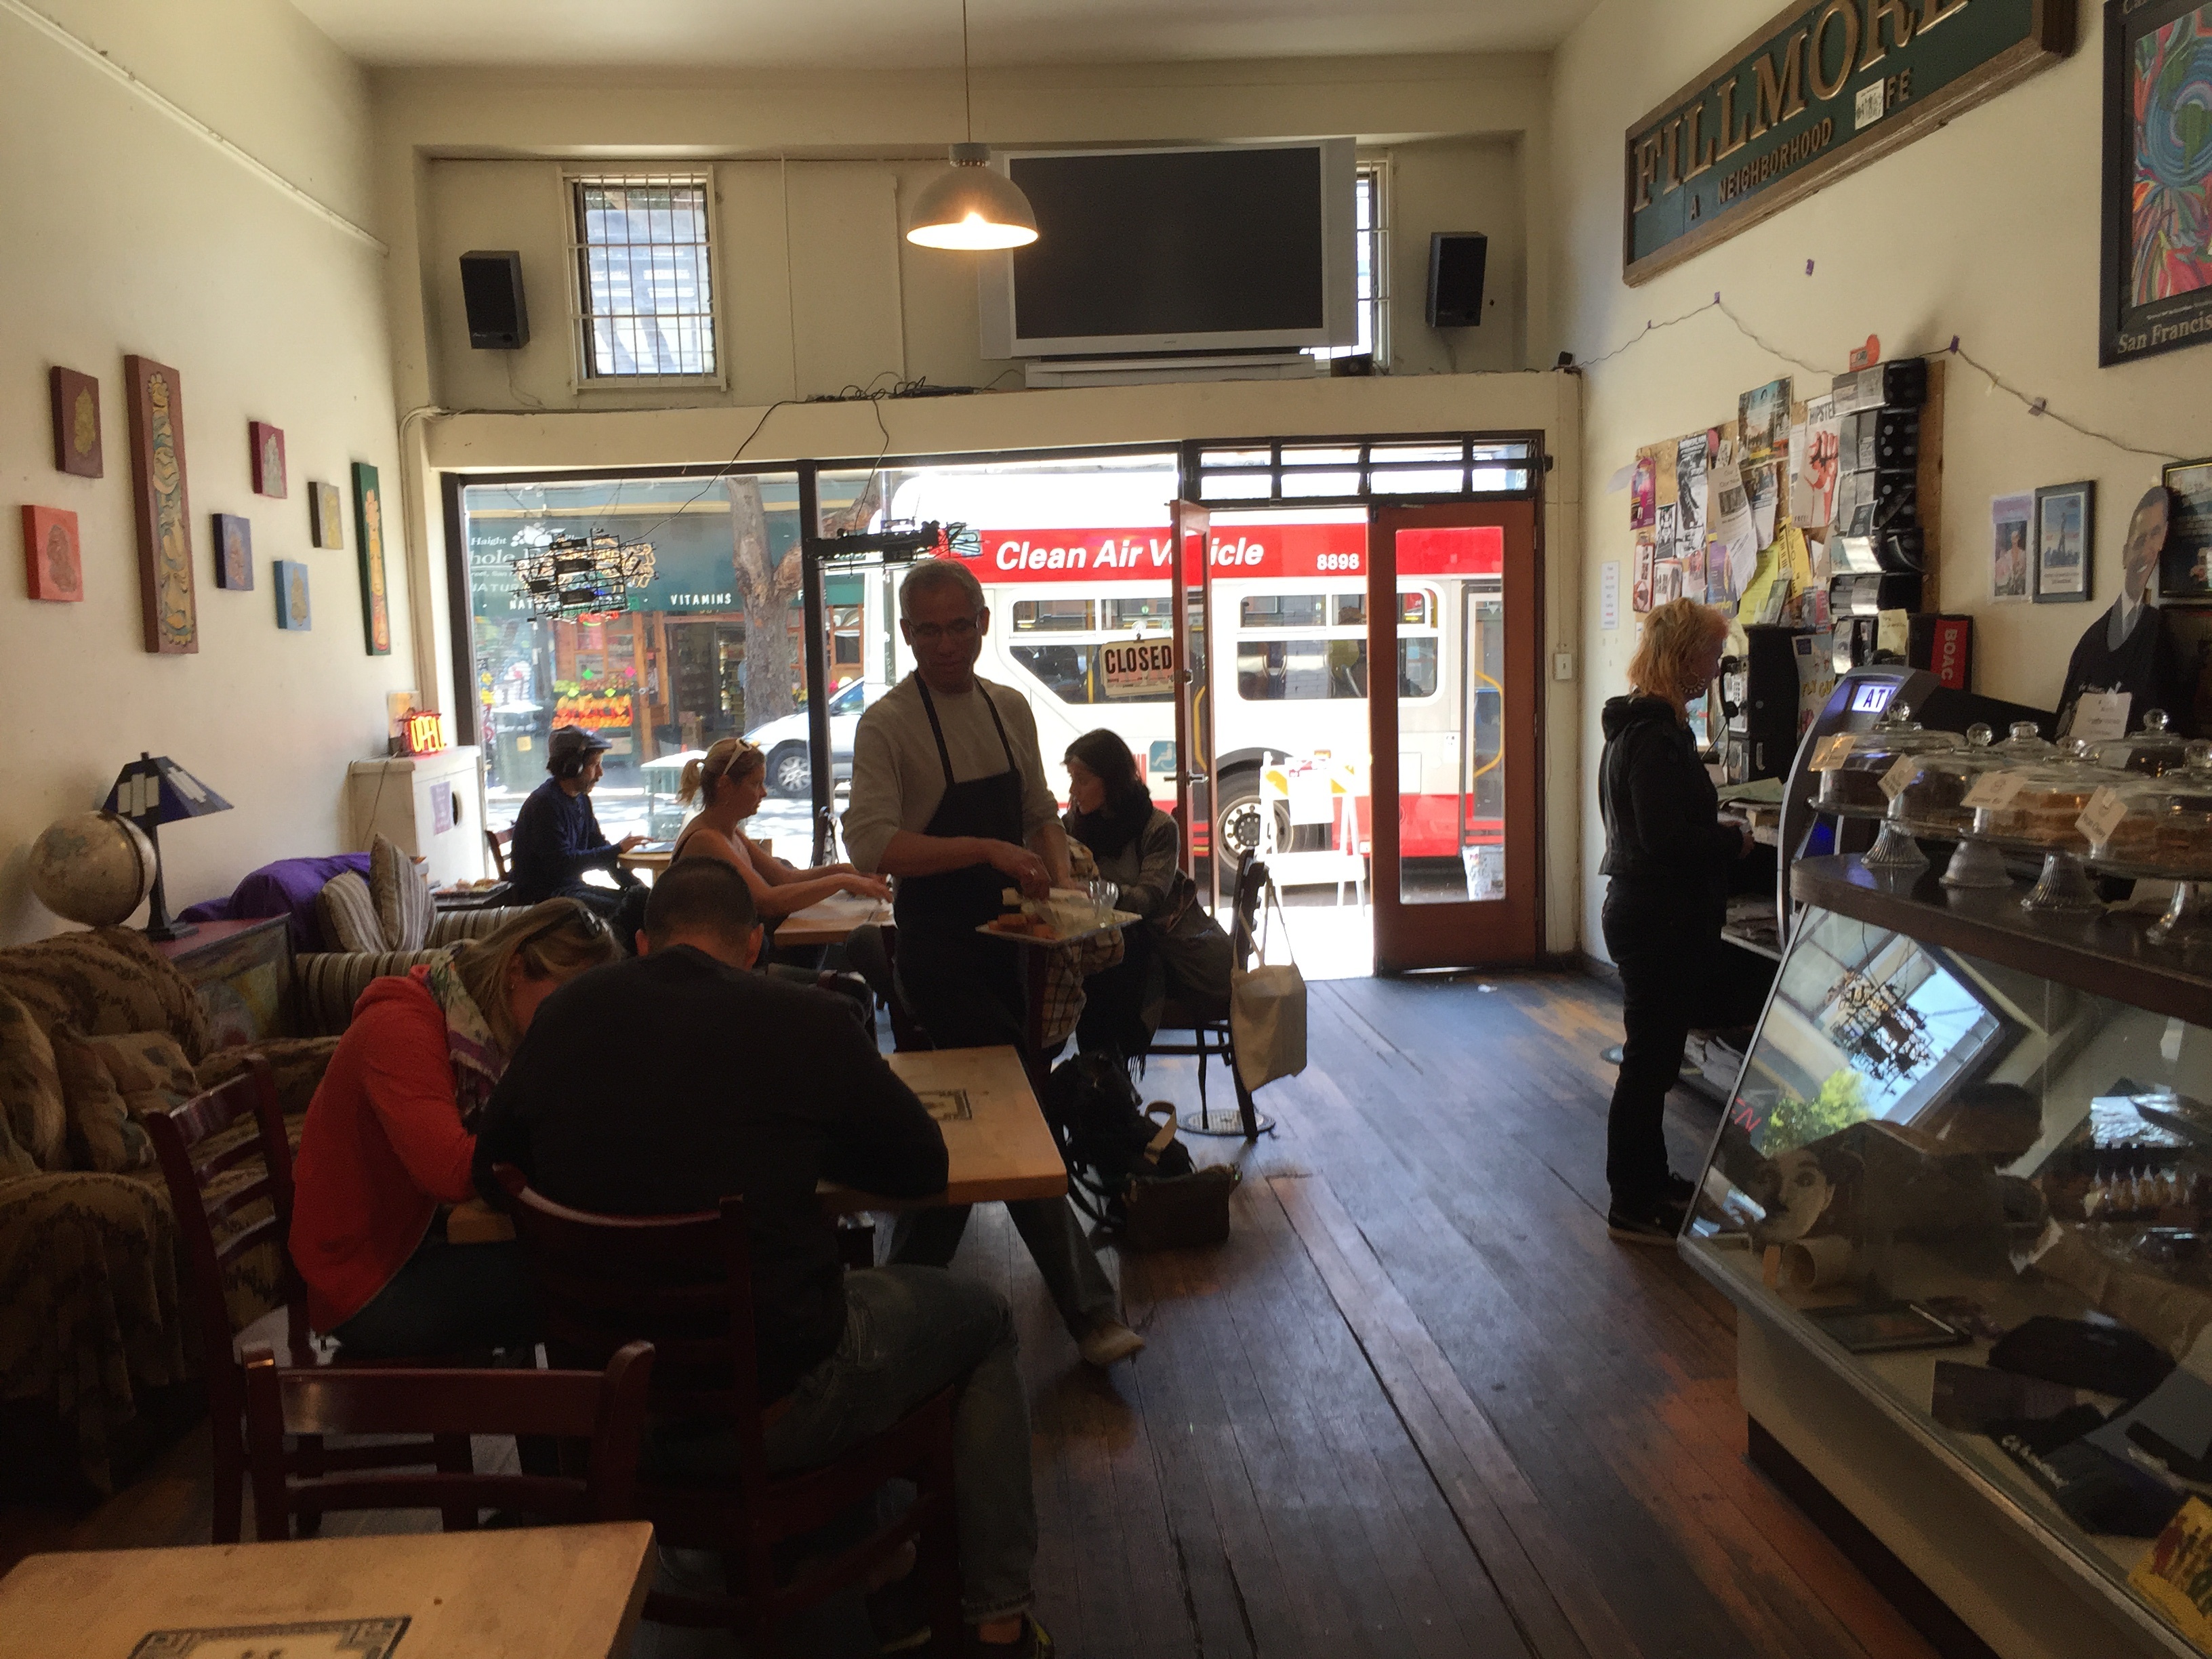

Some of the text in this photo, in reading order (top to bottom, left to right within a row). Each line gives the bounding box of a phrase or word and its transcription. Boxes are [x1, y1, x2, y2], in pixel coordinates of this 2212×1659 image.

[1690, 194, 1700, 220] A
[1719, 117, 1832, 204] NEIGHBORHOOD
[2117, 333, 2147, 354] San
[996, 537, 1264, 570] Clean Air Vicle
[1316, 553, 1359, 570] 8898
[670, 593, 732, 606] VITAMINS
[1105, 644, 1172, 674] CLOSED
[1942, 628, 1958, 681] BOAC
